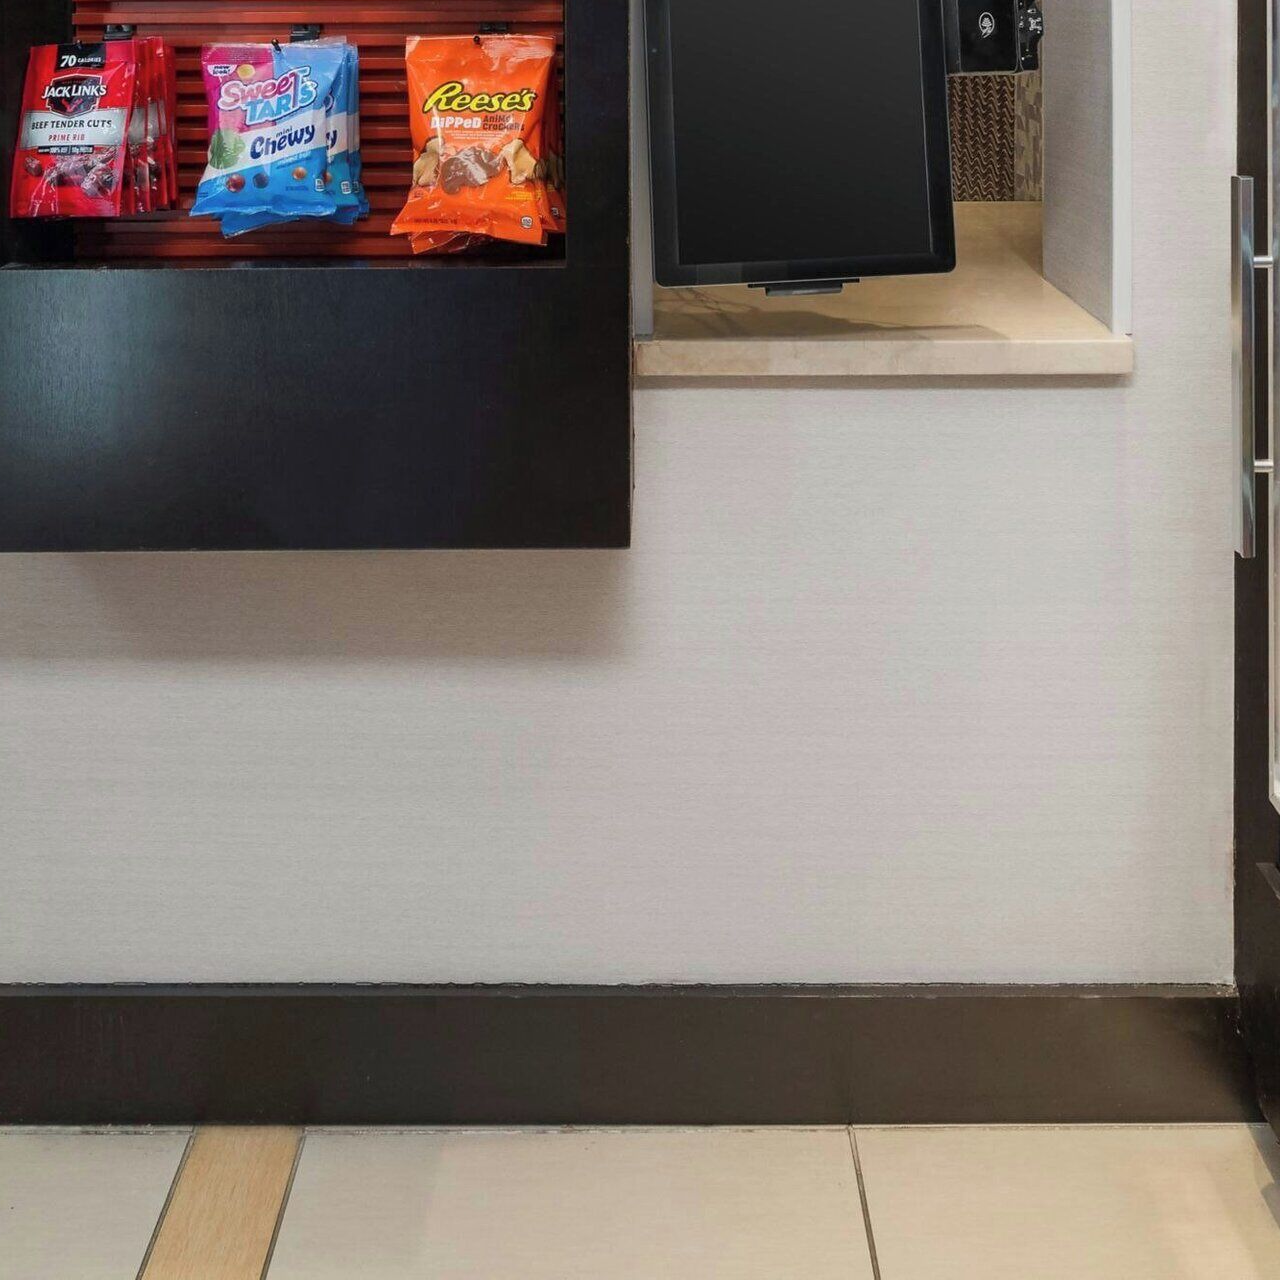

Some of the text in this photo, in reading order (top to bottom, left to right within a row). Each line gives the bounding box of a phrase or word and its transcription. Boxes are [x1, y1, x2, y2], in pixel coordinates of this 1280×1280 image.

[60, 55, 77, 67] 70
[41, 85, 71, 99] JACK
[423, 81, 537, 113] Reese's
[31, 119, 113, 130] BEEF TENDER CUTS
[275, 126, 293, 137] mini
[48, 134, 70, 142] PRIME
[249, 124, 315, 160] Chewy
